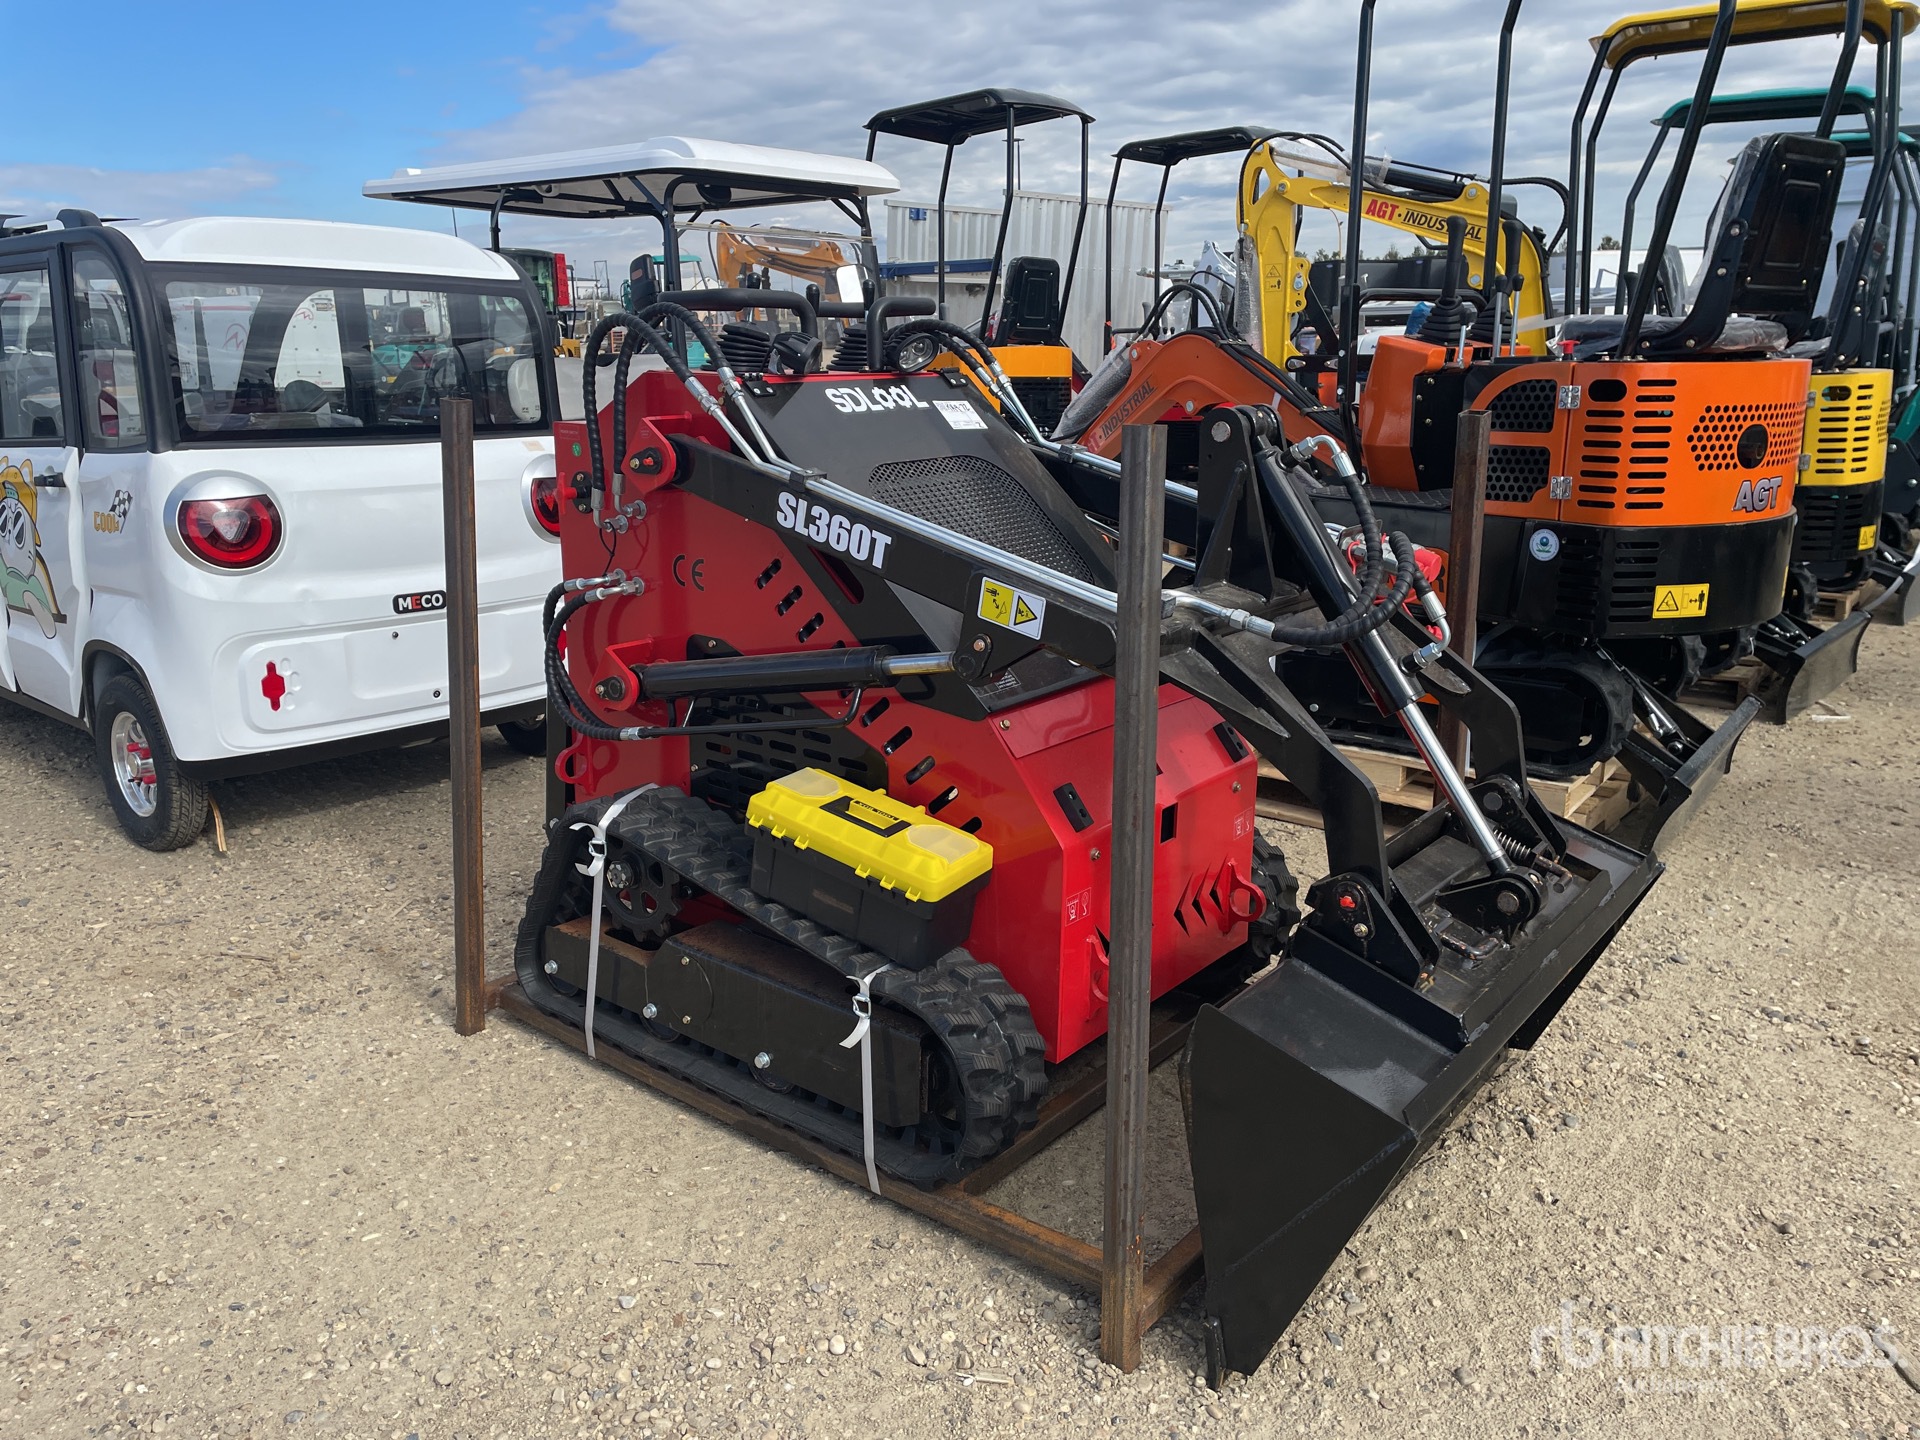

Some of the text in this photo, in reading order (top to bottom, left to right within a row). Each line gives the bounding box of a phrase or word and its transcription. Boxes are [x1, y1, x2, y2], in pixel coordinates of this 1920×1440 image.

[1365, 199, 1482, 239] AGT INDUSAL
[825, 385, 929, 413] SDLOOL
[1101, 381, 1155, 438] INDUSTRIAL
[1732, 475, 1783, 513] AGT
[776, 491, 892, 569] SL360T
[398, 593, 443, 611] MECO
